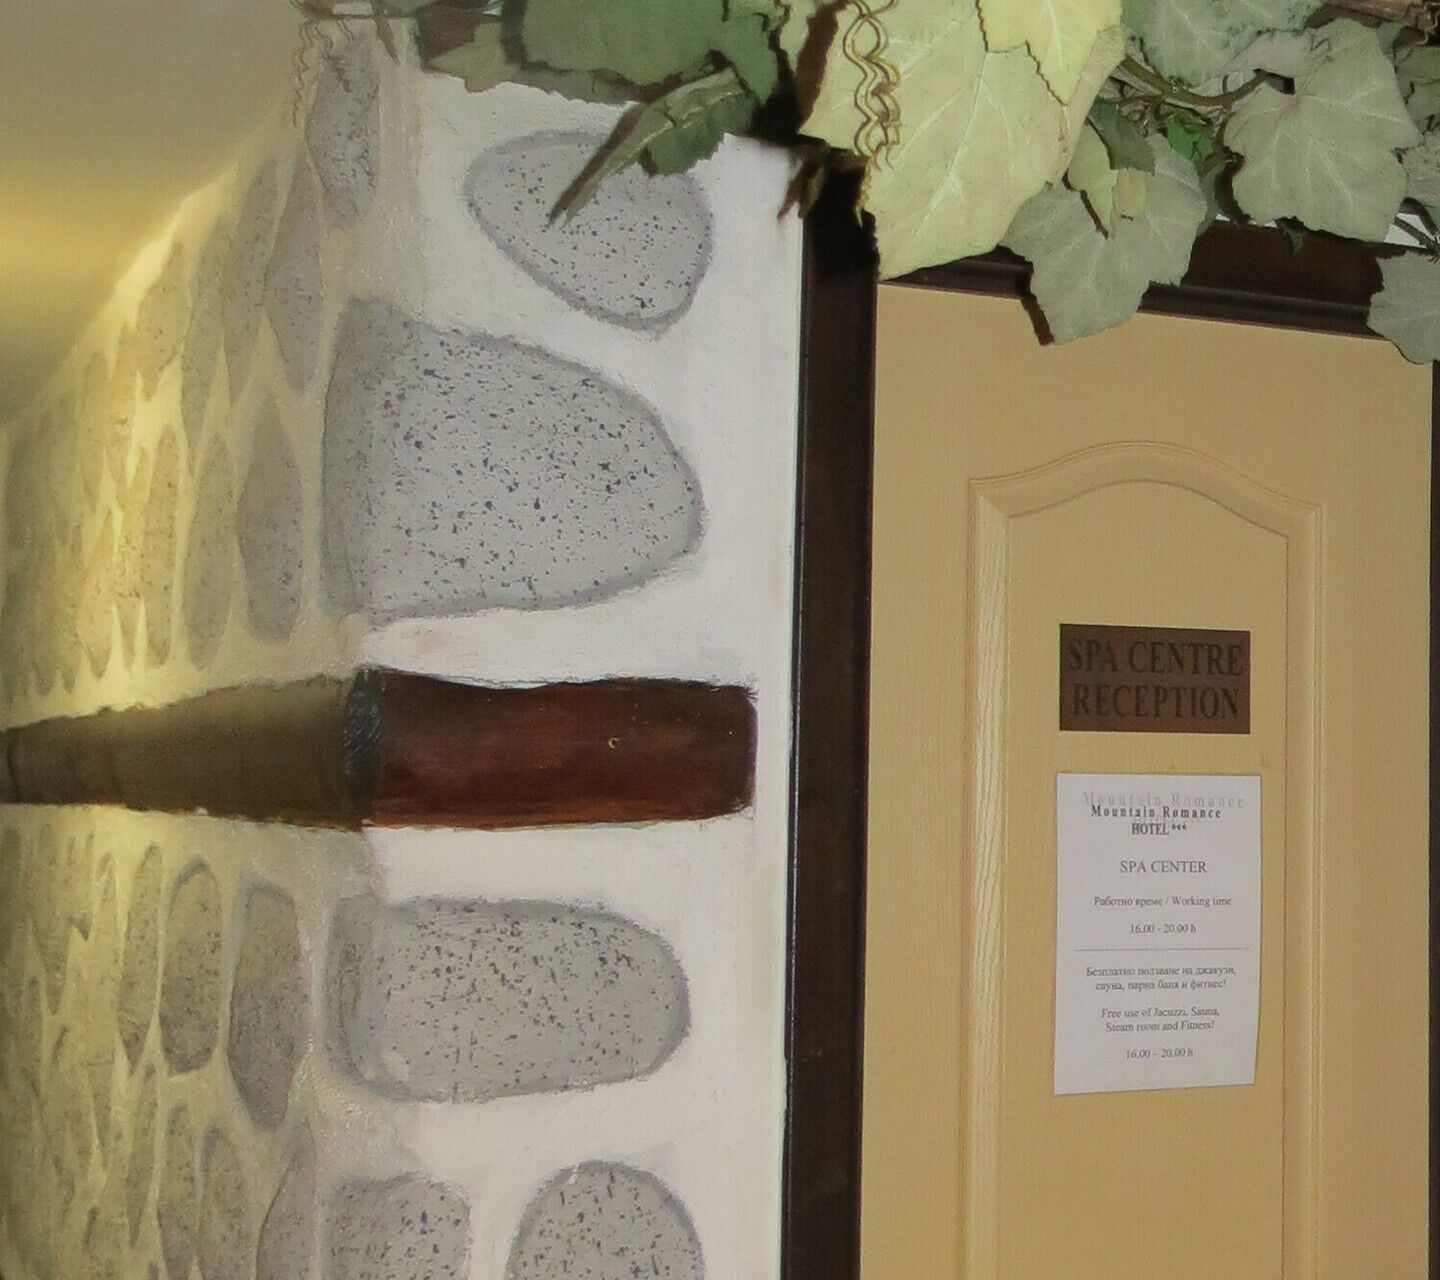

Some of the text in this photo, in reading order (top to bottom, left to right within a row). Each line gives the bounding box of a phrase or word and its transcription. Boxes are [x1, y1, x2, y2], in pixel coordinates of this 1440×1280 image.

[1068, 638, 1243, 676] SPA CENTRE
[1072, 683, 1240, 719] RECEPTION
[1091, 804, 1221, 819] Mountain Romance
[1120, 861, 1207, 874] SPA CENTER
[1094, 896, 1133, 907] Работно
[1172, 896, 1210, 908] Working
[1212, 897, 1232, 906] time
[1101, 1007, 1122, 1018] Free
[1124, 1009, 1139, 1017] use
[1141, 1007, 1153, 1017] of
[1106, 1022, 1134, 1033] Steam
[1162, 1021, 1178, 1030] and
[1180, 1019, 1215, 1031] Fitness!
